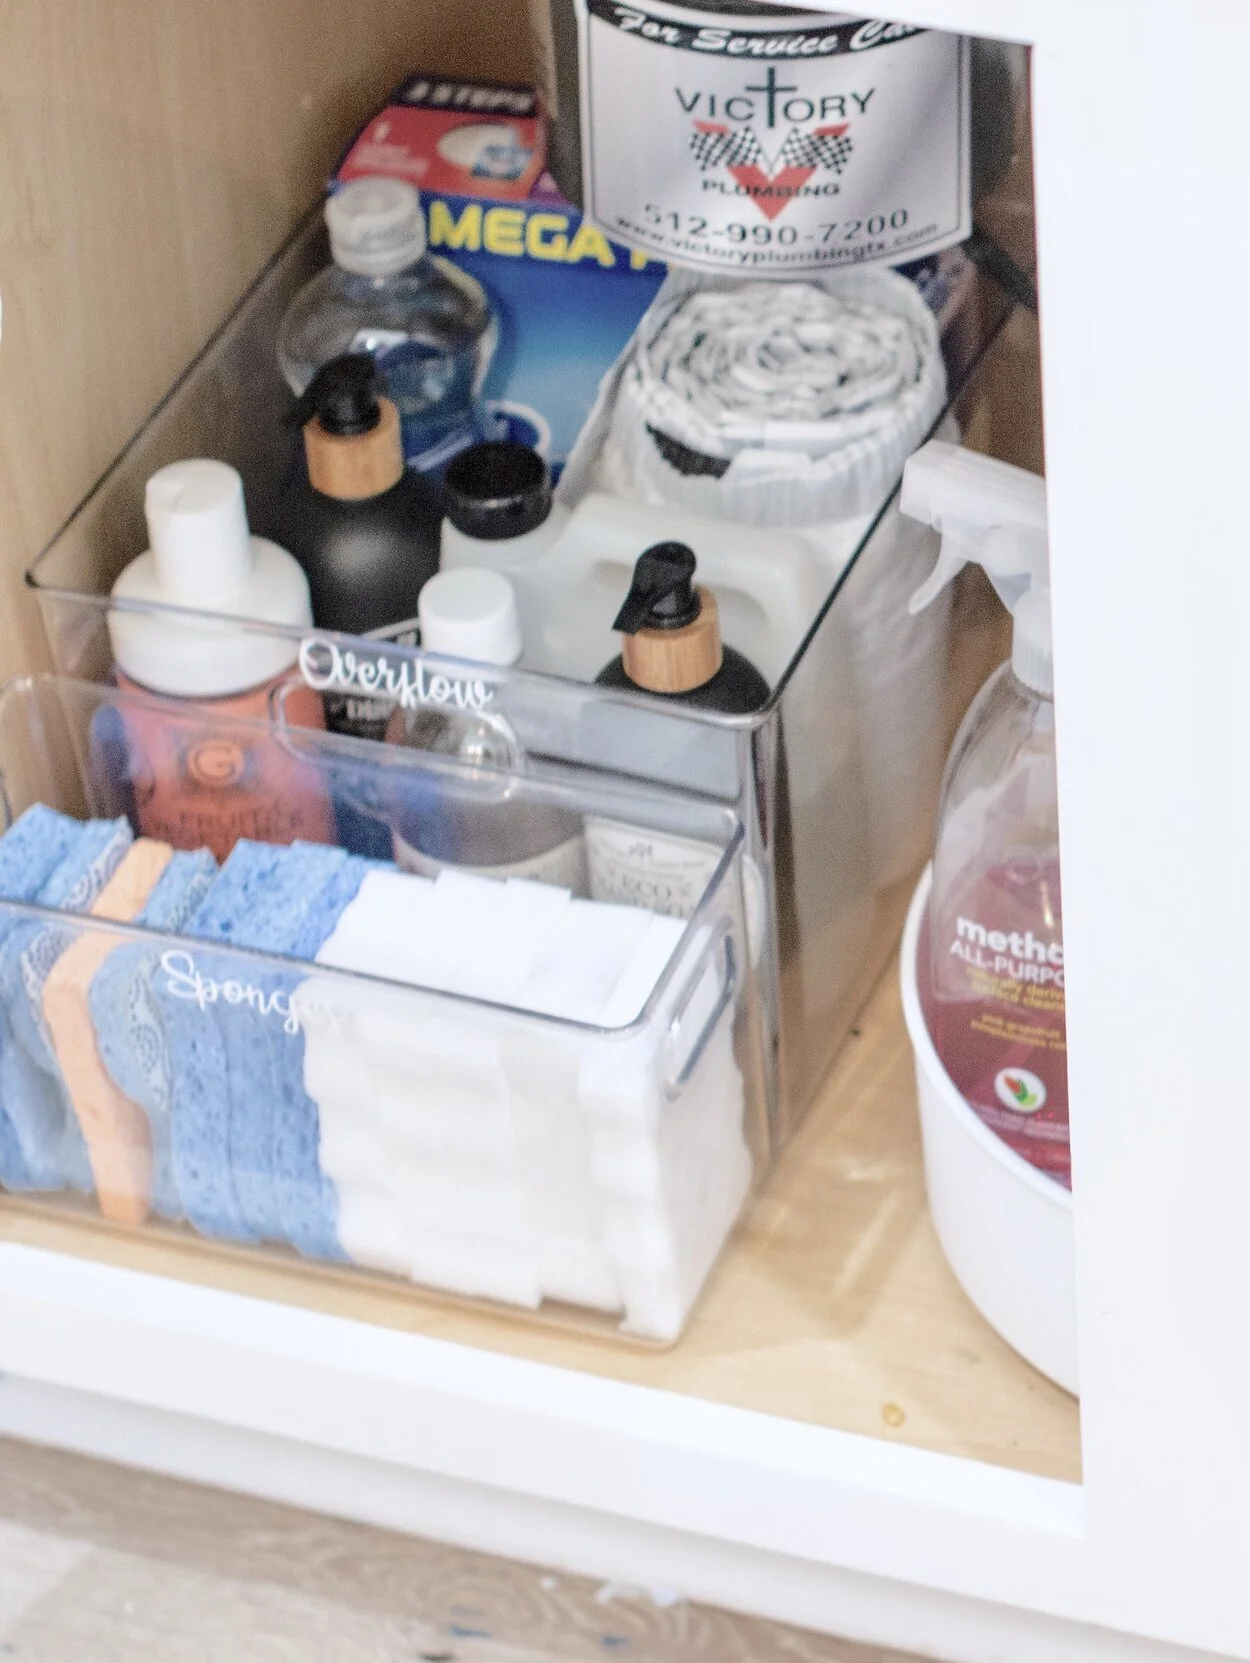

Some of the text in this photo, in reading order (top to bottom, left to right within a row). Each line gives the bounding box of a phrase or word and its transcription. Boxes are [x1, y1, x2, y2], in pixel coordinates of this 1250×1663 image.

[613, 6, 921, 57] For Service Ca
[673, 66, 877, 129] VICTORY
[701, 178, 841, 198] PLUMBING
[428, 200, 616, 270] MEGA
[644, 206, 910, 247] 512-990-7200
[298, 638, 494, 713] Overflow
[949, 938, 1066, 989] ALL-PURPO
[956, 915, 1065, 966] metho
